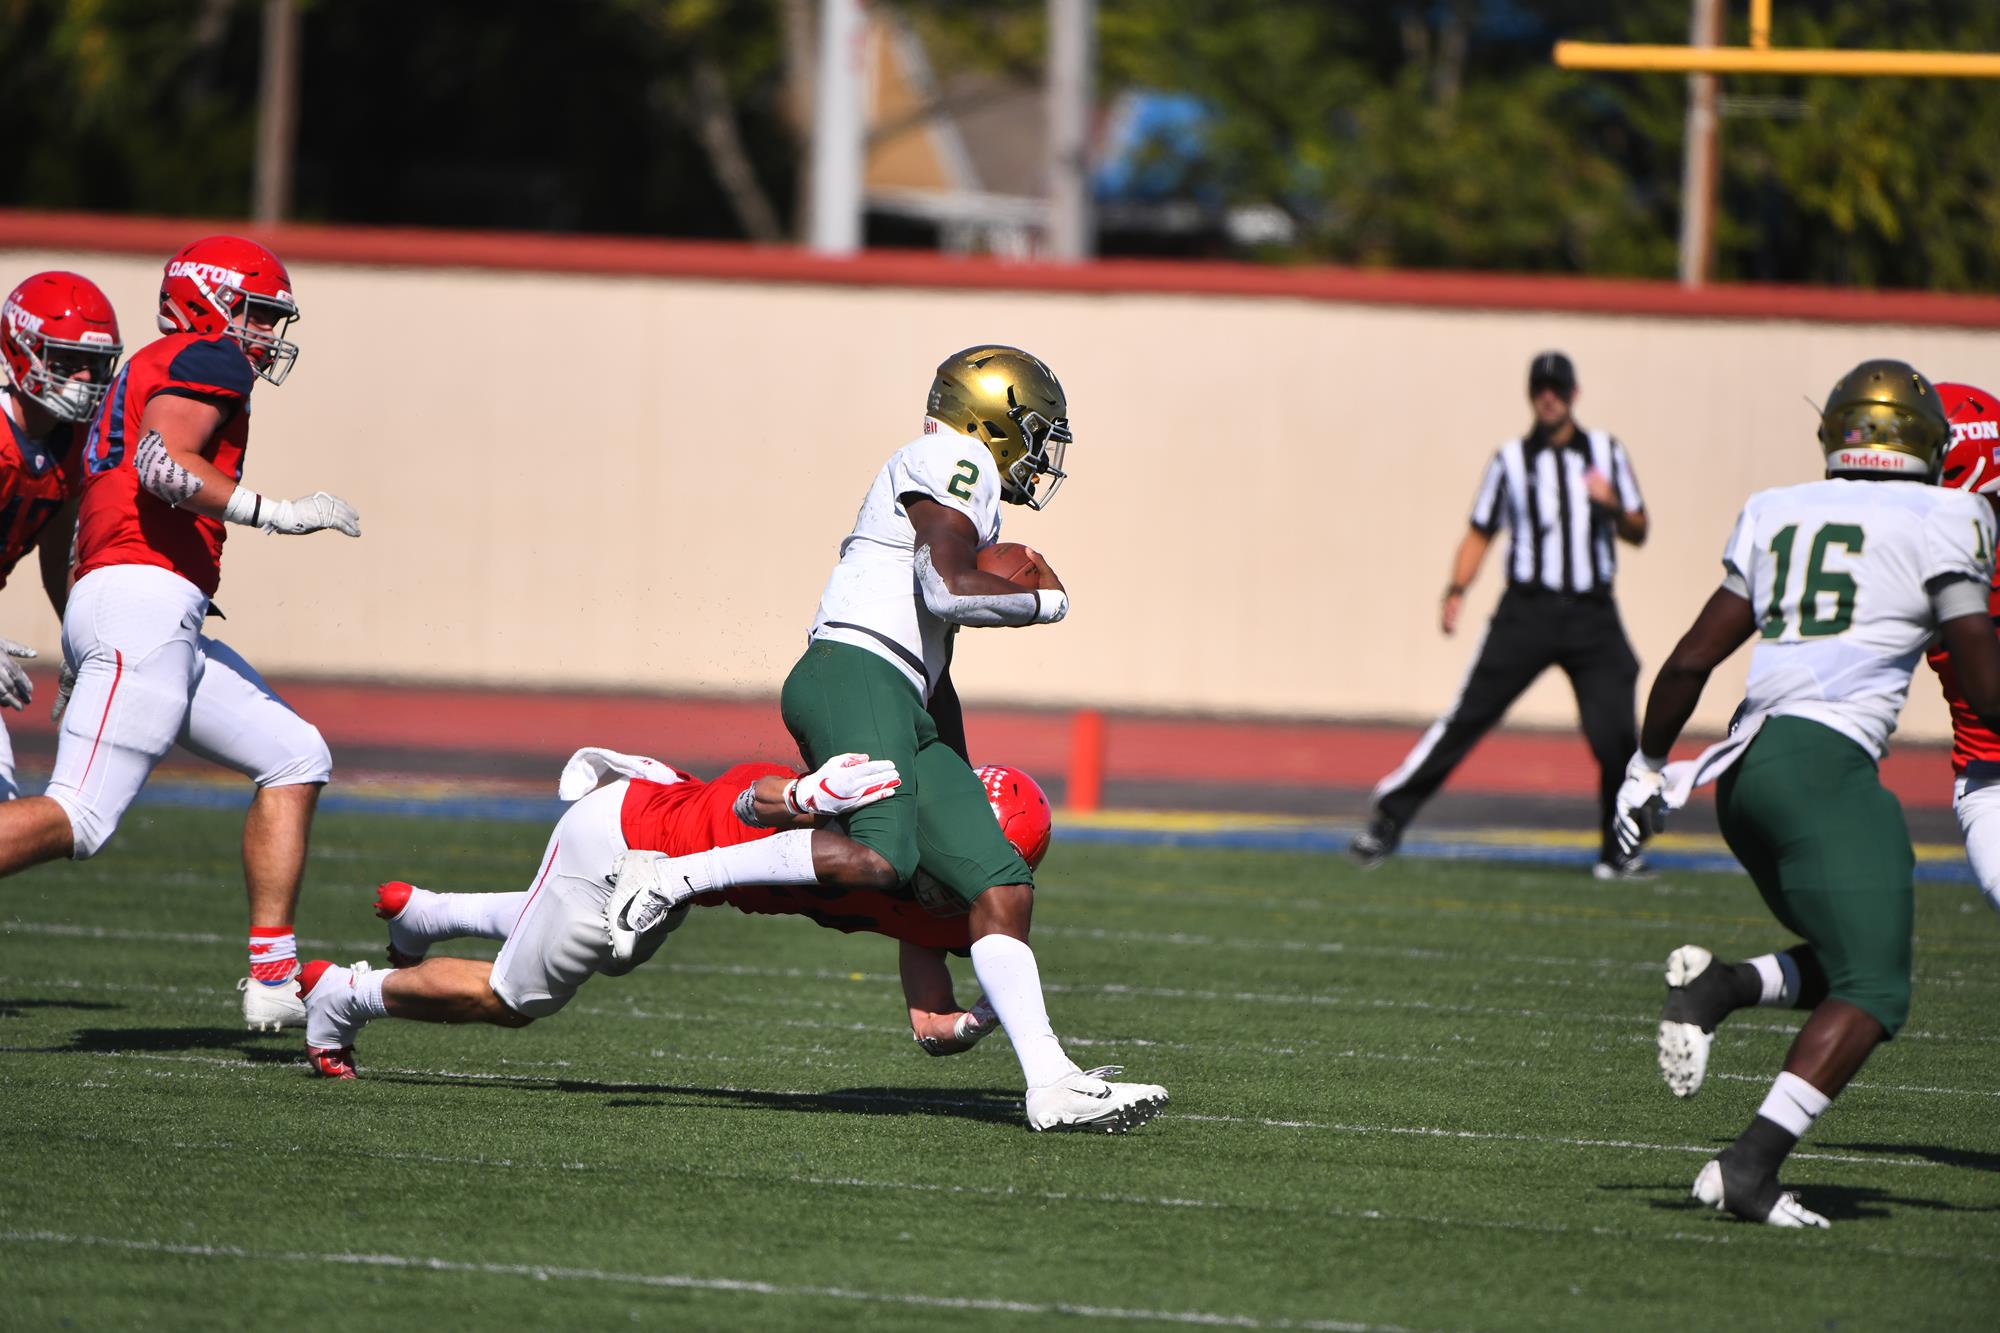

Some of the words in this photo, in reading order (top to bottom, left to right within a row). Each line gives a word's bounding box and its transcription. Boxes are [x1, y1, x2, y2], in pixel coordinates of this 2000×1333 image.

[168, 261, 245, 288] DAYTON
[1950, 421, 1998, 441] TON
[1841, 453, 1904, 468] Riddell
[947, 459, 980, 501] 2
[1760, 523, 1865, 639] 16
